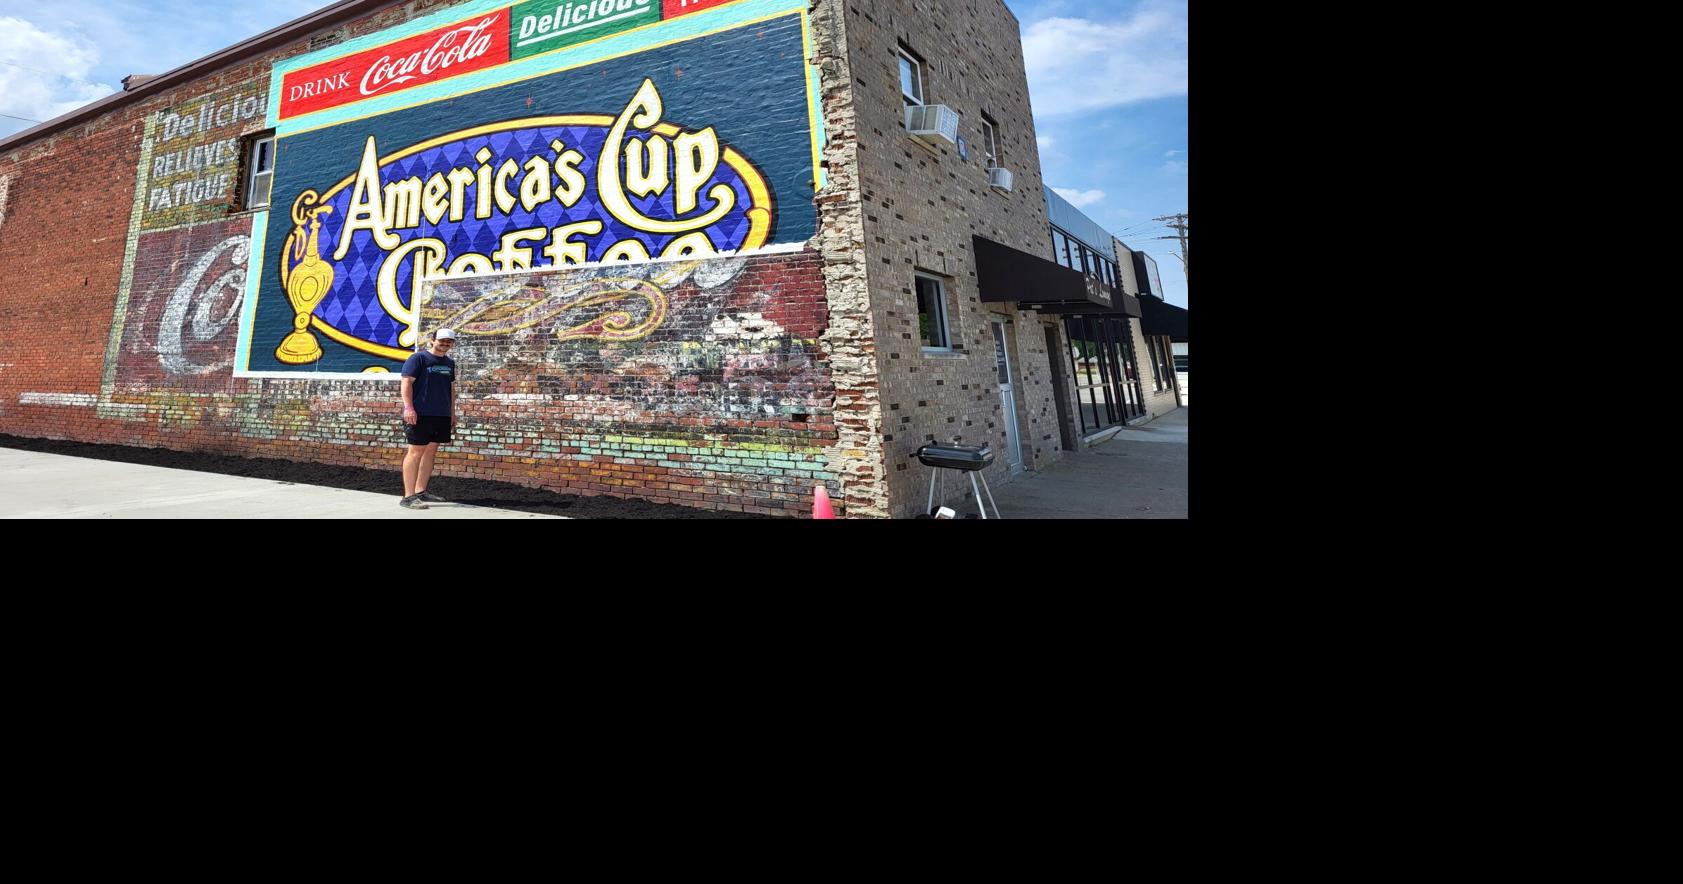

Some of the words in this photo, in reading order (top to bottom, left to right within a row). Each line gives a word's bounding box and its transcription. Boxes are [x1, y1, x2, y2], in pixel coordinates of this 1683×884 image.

[289, 72, 351, 102] DRINK
[359, 13, 500, 96] Coca-Cola
[148, 173, 230, 212] FATIGUE
[333, 135, 586, 261] America's
[598, 78, 734, 233] Cup
